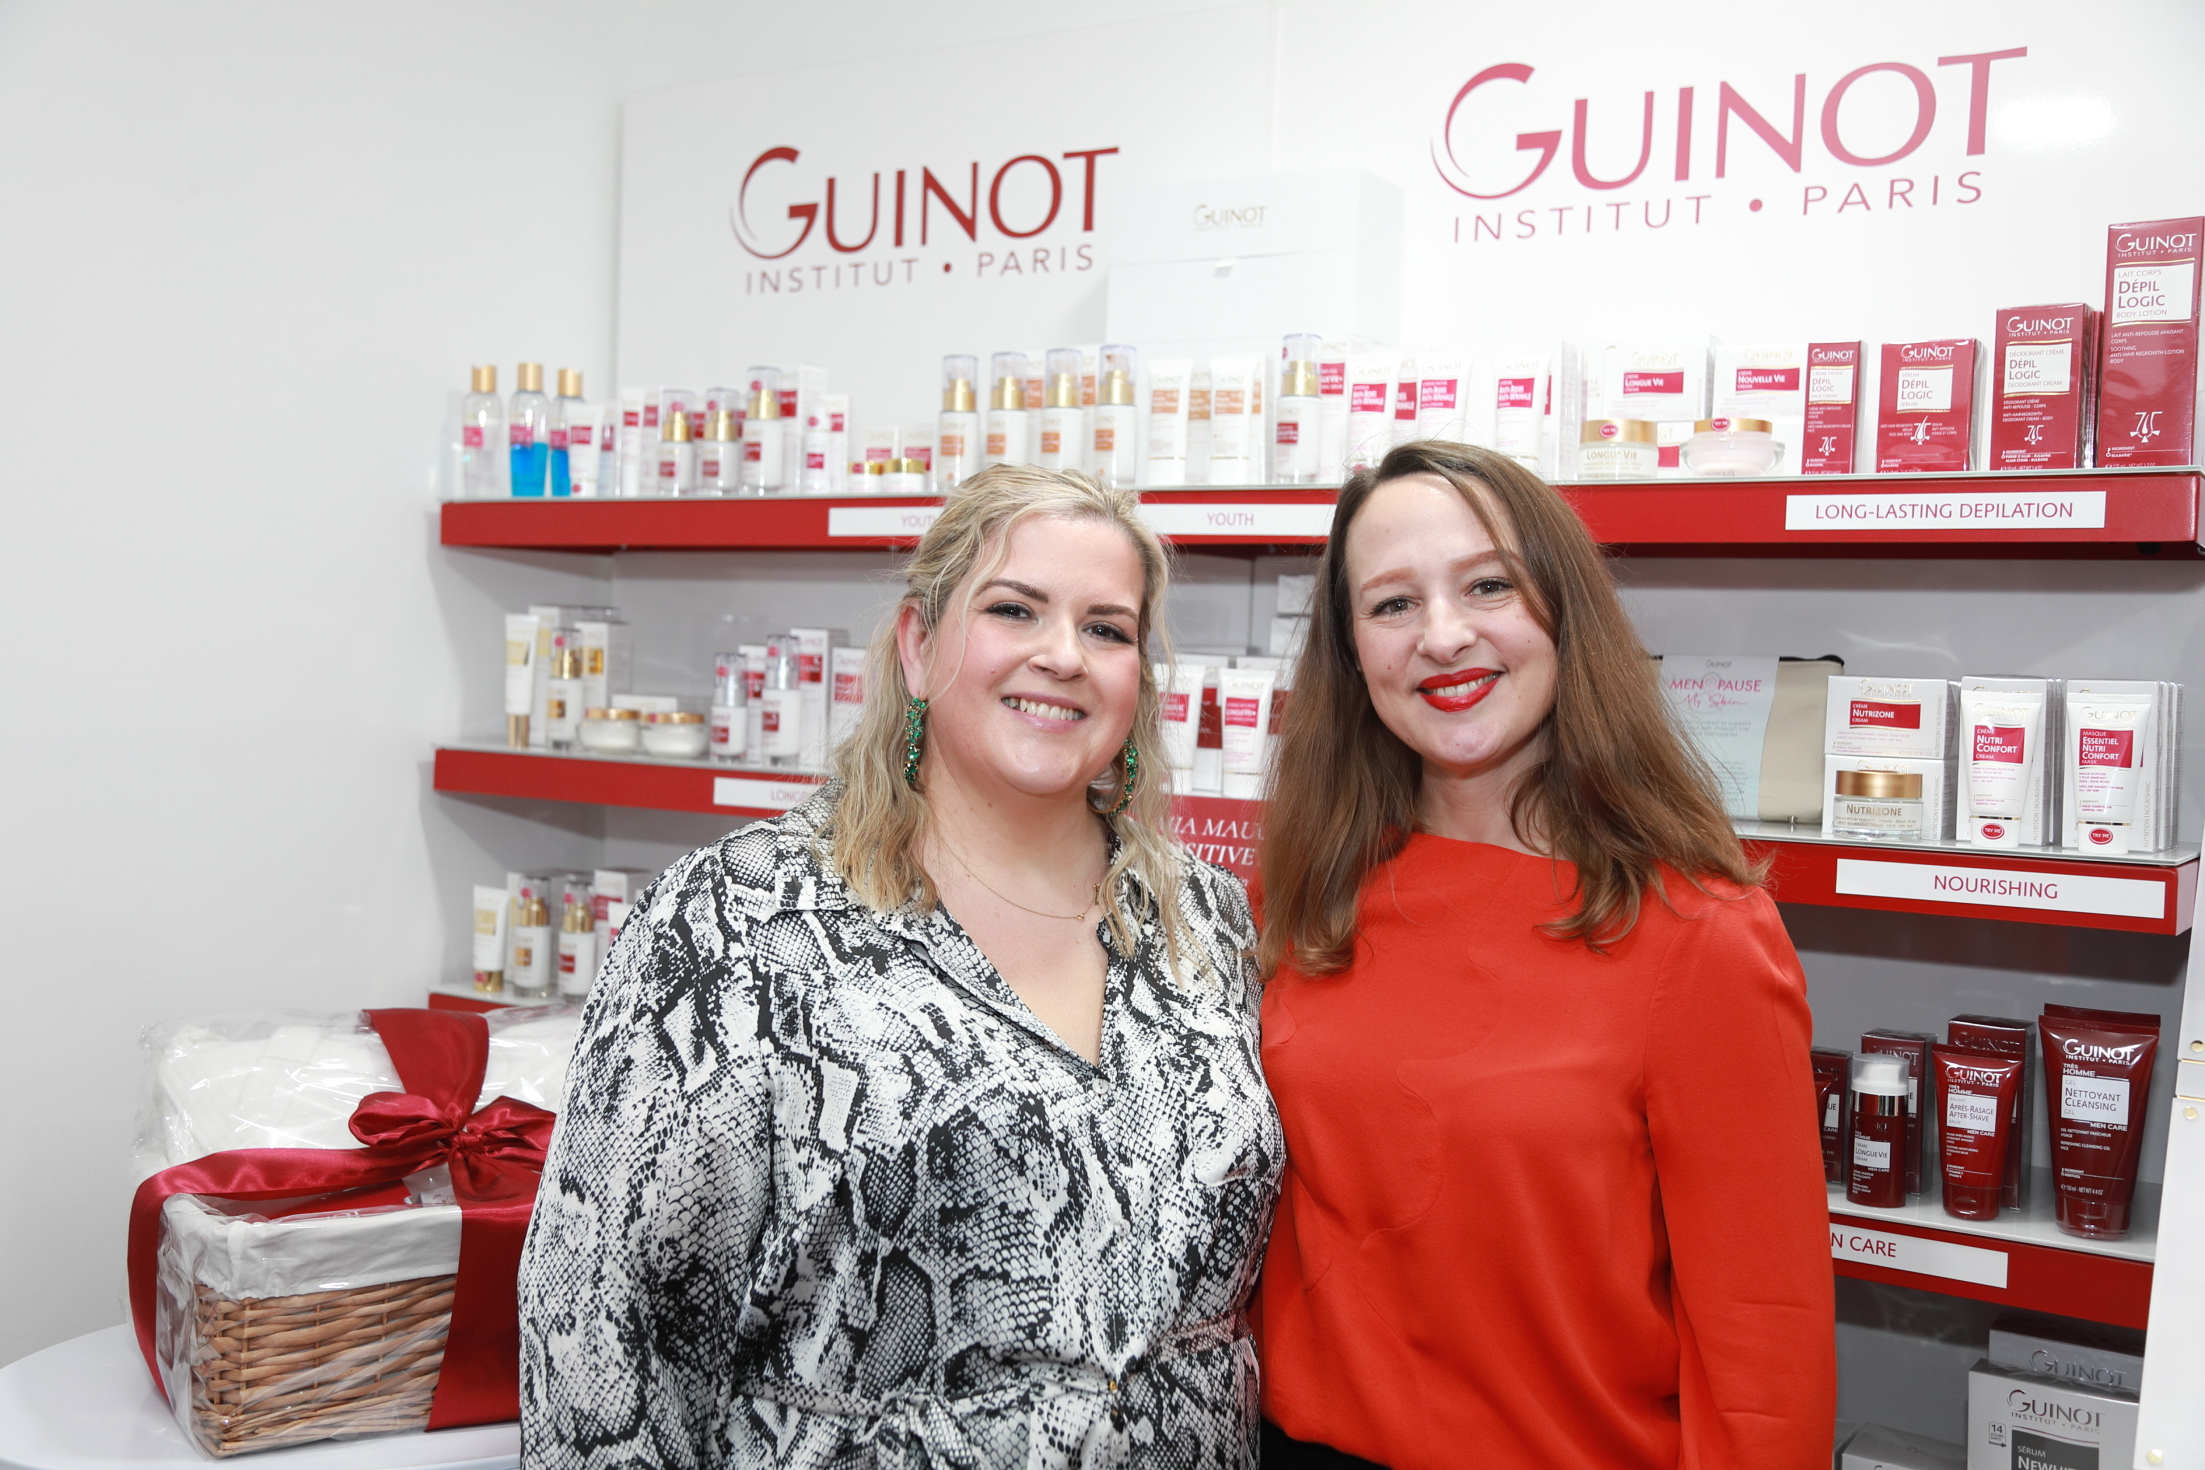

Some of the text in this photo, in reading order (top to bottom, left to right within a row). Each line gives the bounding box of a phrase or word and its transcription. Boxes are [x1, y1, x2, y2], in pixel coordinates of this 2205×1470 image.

[1430, 46, 2028, 200] GUINOT
[730, 147, 1120, 260] GUINOT
[1453, 171, 1982, 243] INSTITUT PARIS
[1193, 204, 1268, 227] GUINOT
[2115, 233, 2198, 253] GUINOT
[2118, 249, 2156, 258] INSTITUT
[745, 244, 1094, 295] INSTITUT PARIS
[2118, 269, 2162, 278] LAIT CORPS
[2118, 279, 2160, 294] DÉPIL
[2117, 294, 2166, 309] LOGIC
[2116, 310, 2136, 318] BODY
[2006, 316, 2074, 333] GUINOT
[1811, 348, 1854, 360] GUINOT
[1900, 344, 1955, 359] GUINOT
[2009, 358, 2037, 369] DÉPIL
[1737, 374, 1785, 384] NOUVELLE VIE
[1812, 377, 1831, 385] DÉPIL
[2009, 370, 2041, 380] LOGIC
[1625, 377, 1664, 388] LONGUE VIE
[1901, 378, 1929, 389] DÉPIL
[1901, 390, 1933, 400] LOGIC
[1623, 449, 1638, 460] VIE
[1815, 502, 2073, 519] LONG-LASTING DEPILATION
[901, 514, 939, 528] YOUT
[1207, 512, 1254, 526] YOUTH
[1859, 678, 1914, 694] GUINOT
[1852, 709, 1895, 719] NUTRIZONE
[1934, 730, 1942, 758] NUTRITION
[1976, 735, 2003, 744] NUTRI
[2082, 736, 2119, 745] ESSENTIEL
[1976, 743, 2018, 753] CONFORT
[2082, 744, 2106, 752] NUTRI
[2081, 751, 2119, 760] CONFORT
[1846, 804, 1903, 816] NUTRIZONE
[1177, 842, 1256, 866] SITIVE
[1934, 874, 2058, 899] NOURISHING
[2063, 1038, 2134, 1060] GUINOT
[2065, 1054, 2099, 1062] INSTITUT
[1945, 1065, 2003, 1084] GUINOT
[2063, 1068, 2096, 1078] HOMME
[1948, 1088, 1973, 1096] HOMME
[2065, 1087, 2121, 1102] NETTOYANT
[1949, 1103, 1994, 1115] APRÈS-RASAGE
[2065, 1097, 2116, 1112] CLEANSING
[1949, 1110, 1989, 1122] AFTER-SHAVE
[2107, 1124, 2128, 1132] CARE
[1855, 1148, 1888, 1159] LONGUE VIE
[1850, 1236, 1897, 1258] CARE
[2029, 1350, 2127, 1386] GUINOT
[2007, 1389, 2105, 1427] GUINOT
[1991, 1424, 2003, 1433] 14
[2011, 1411, 2100, 1434] INSTITUT PARIS
[2017, 1445, 2046, 1458] SÉRUM
